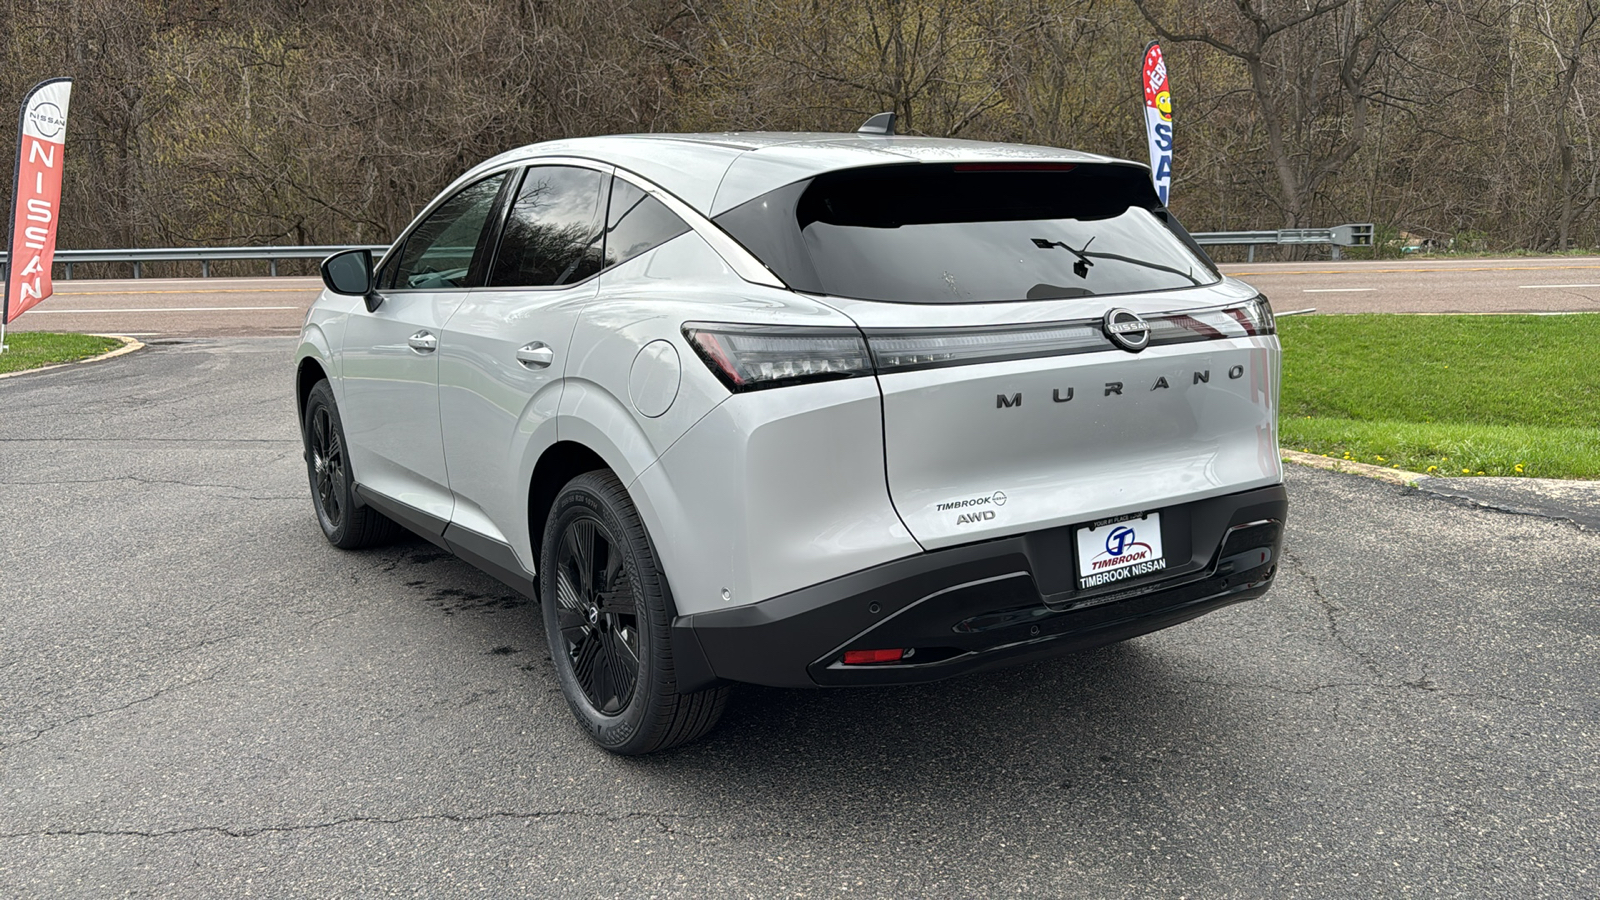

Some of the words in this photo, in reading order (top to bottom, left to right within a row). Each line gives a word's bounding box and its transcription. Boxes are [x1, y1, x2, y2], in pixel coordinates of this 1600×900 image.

[30, 111, 65, 126] NISSAN
[20, 140, 54, 304] NISSAN
[1109, 322, 1150, 333] NISSAN
[996, 364, 1244, 409] MURANO
[936, 496, 991, 511] TIMBROOK
[957, 510, 996, 525] AWD
[1091, 550, 1147, 570] TIMBROOK
[1080, 567, 1131, 589] TIMBROOK
[1132, 558, 1166, 576] NISSAN
